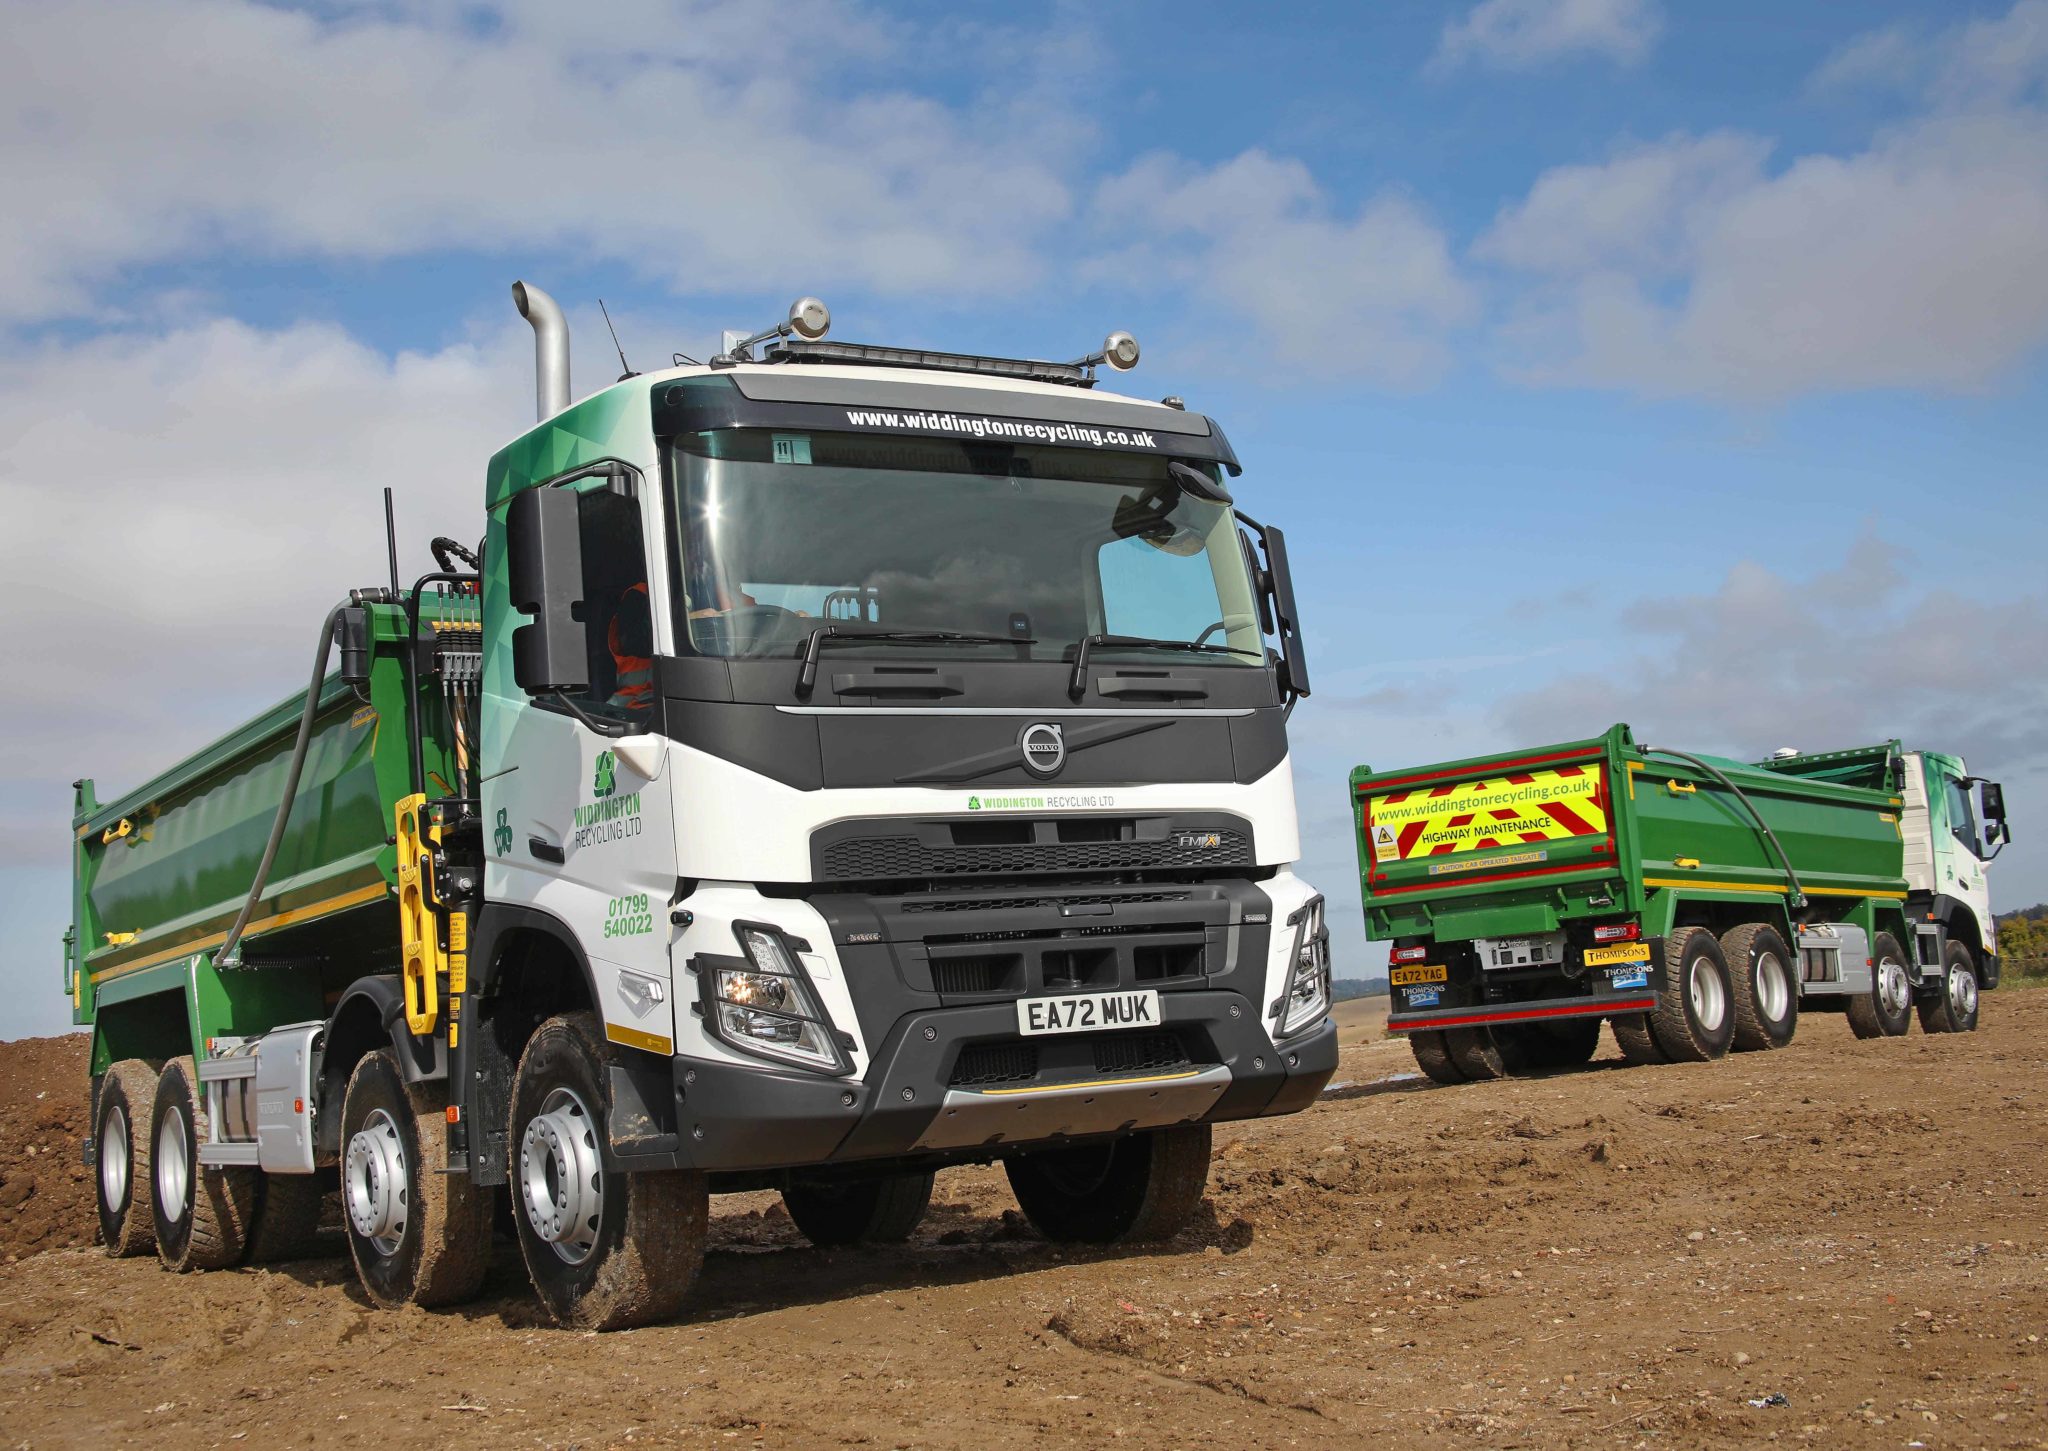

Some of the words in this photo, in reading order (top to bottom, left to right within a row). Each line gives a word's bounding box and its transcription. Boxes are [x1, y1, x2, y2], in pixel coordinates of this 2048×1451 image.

[846, 410, 1157, 448] www.widdingtonrecycling.co.uk
[777, 442, 788, 455] 11
[574, 791, 641, 828] WIDDINGTON
[983, 797, 1044, 809] WIDDINGTON
[1047, 796, 1097, 808] RECYCLING
[1099, 796, 1114, 807] LTD
[1378, 779, 1590, 821] www.widdingtonrecycling.co.uk
[575, 820, 623, 849] RECYCLING
[625, 816, 642, 837] LTD
[1422, 828, 1471, 844] HIGHWAY
[1474, 816, 1551, 836] MAINTENANCE
[1180, 834, 1219, 849] FMX
[1480, 857, 1509, 868] OPERATED
[608, 893, 648, 917] 01799
[604, 913, 653, 939] 540022
[1588, 947, 1646, 962] THOMPSONS
[1395, 971, 1421, 982] EA72
[1423, 969, 1442, 979] YAG
[1603, 964, 1654, 978] THOMPSONS
[1401, 984, 1446, 997] THOMPSONS
[1027, 999, 1096, 1030] EA72
[1101, 994, 1150, 1024] MUK
